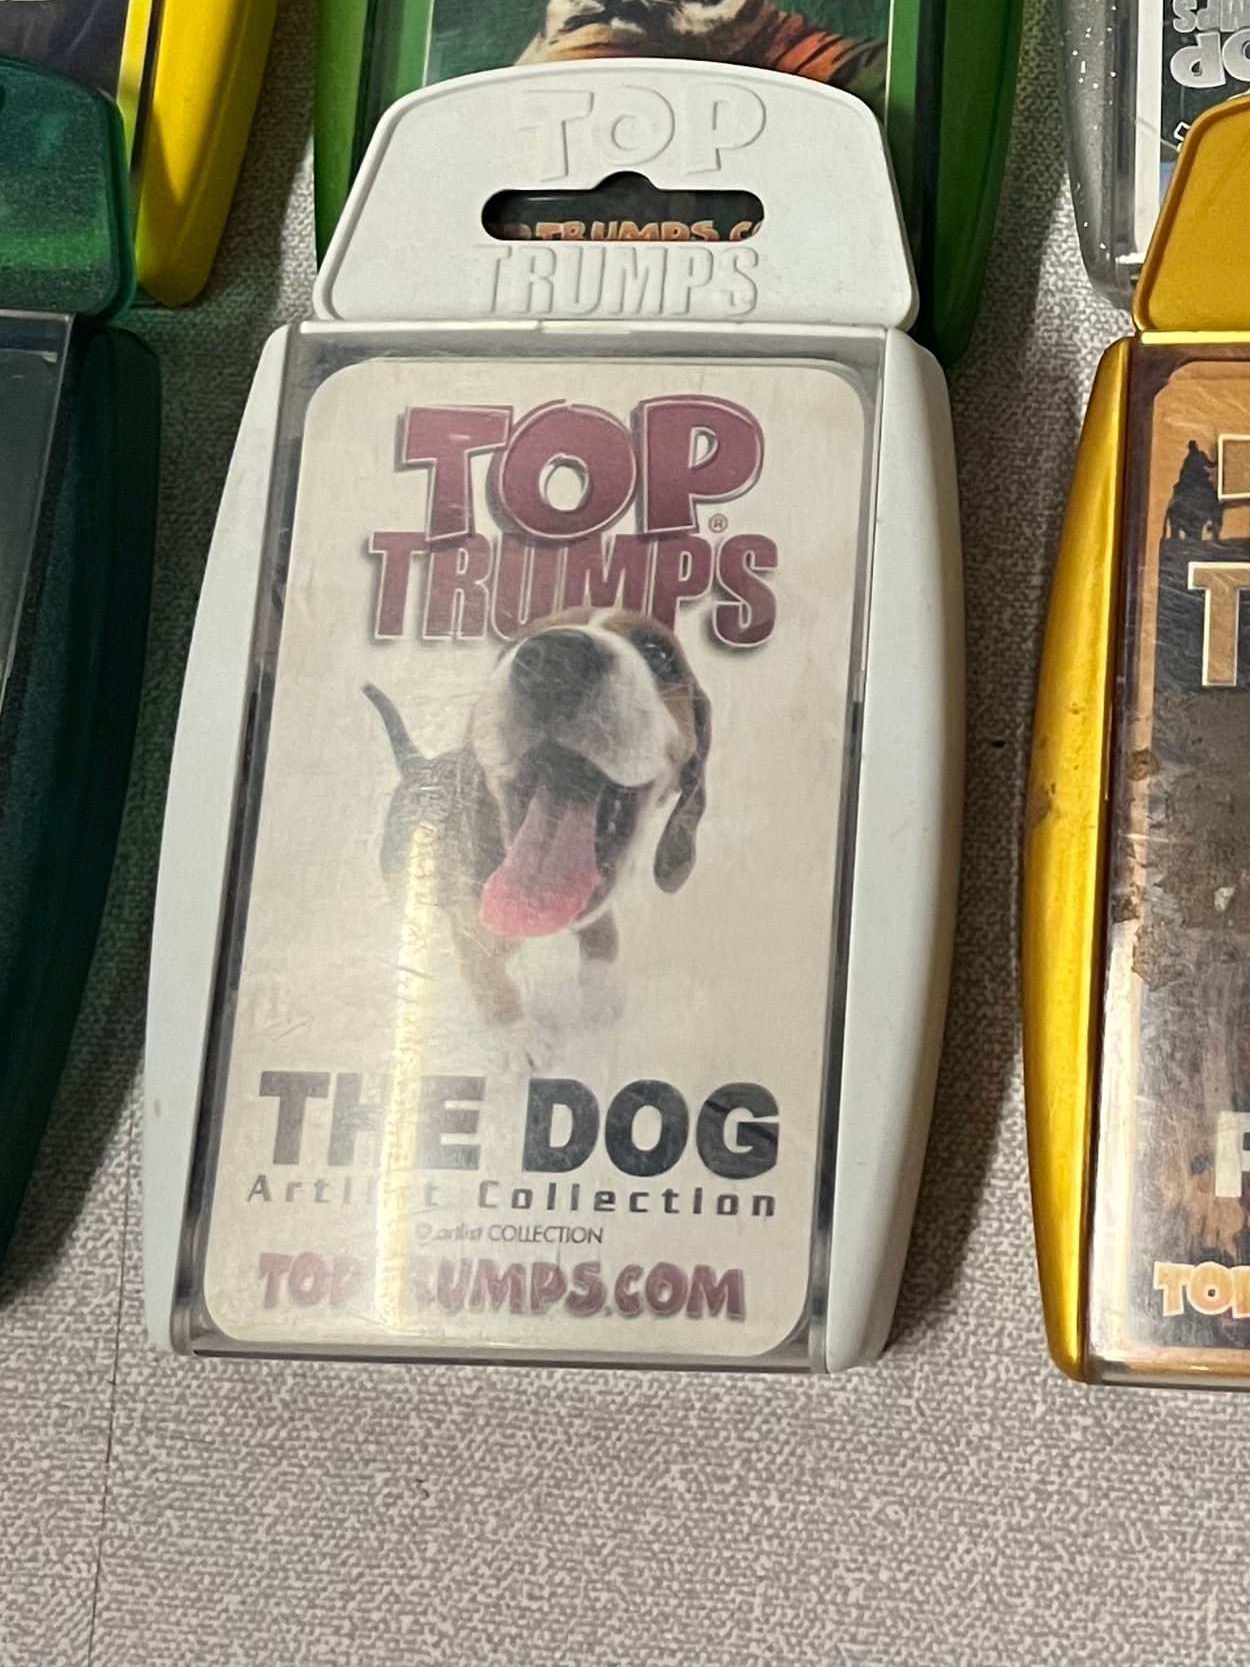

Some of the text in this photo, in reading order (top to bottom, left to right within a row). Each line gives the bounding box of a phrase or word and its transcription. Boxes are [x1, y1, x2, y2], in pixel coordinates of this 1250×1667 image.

[519, 82, 768, 183] TOP
[472, 244, 760, 317] TRUMPS
[400, 394, 765, 543] TOP
[368, 532, 779, 648] TRUMPS
[521, 1077, 782, 1180] DOG
[477, 1179, 776, 1218] Collection
[488, 1224, 604, 1244] COLLECTION
[258, 1251, 746, 1323] TOPRUMPS.COM
